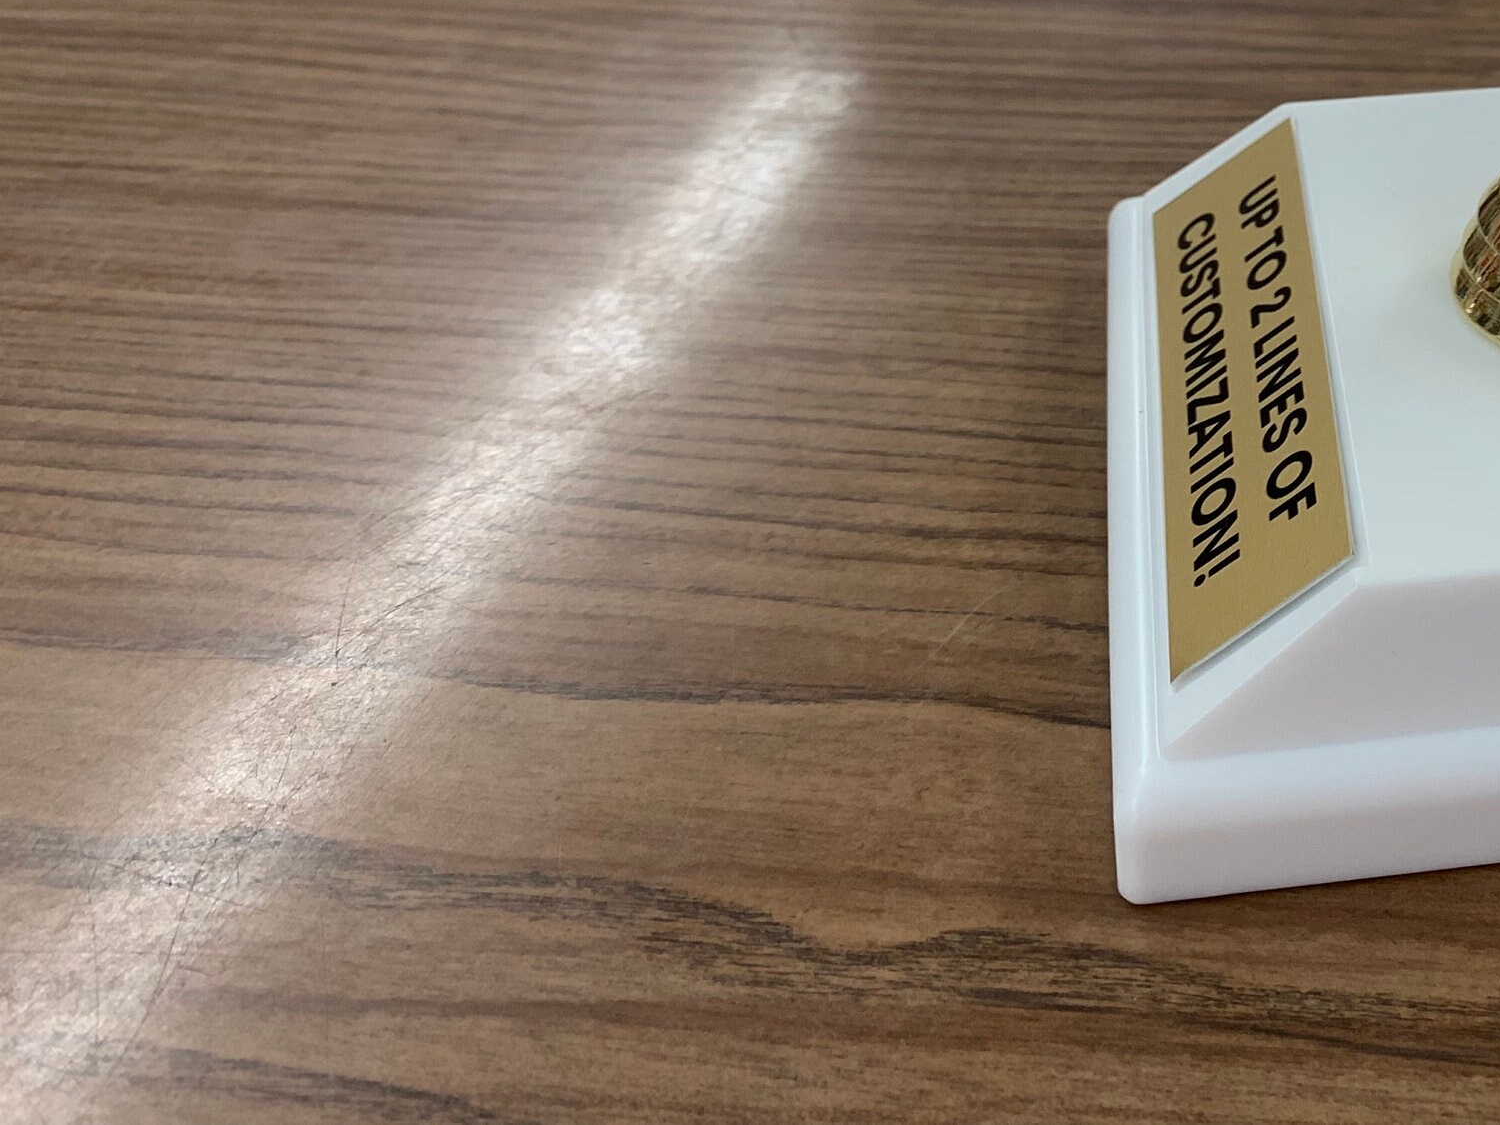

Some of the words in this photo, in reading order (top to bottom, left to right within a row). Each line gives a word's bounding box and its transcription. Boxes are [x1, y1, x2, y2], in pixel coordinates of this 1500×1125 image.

[1238, 175, 1280, 230] UP
[1244, 225, 1288, 291] TO
[1249, 285, 1292, 329] 2
[1177, 212, 1241, 588] CUSTOMIZATION!
[1252, 315, 1308, 454] LINES
[1265, 450, 1317, 522] OF
